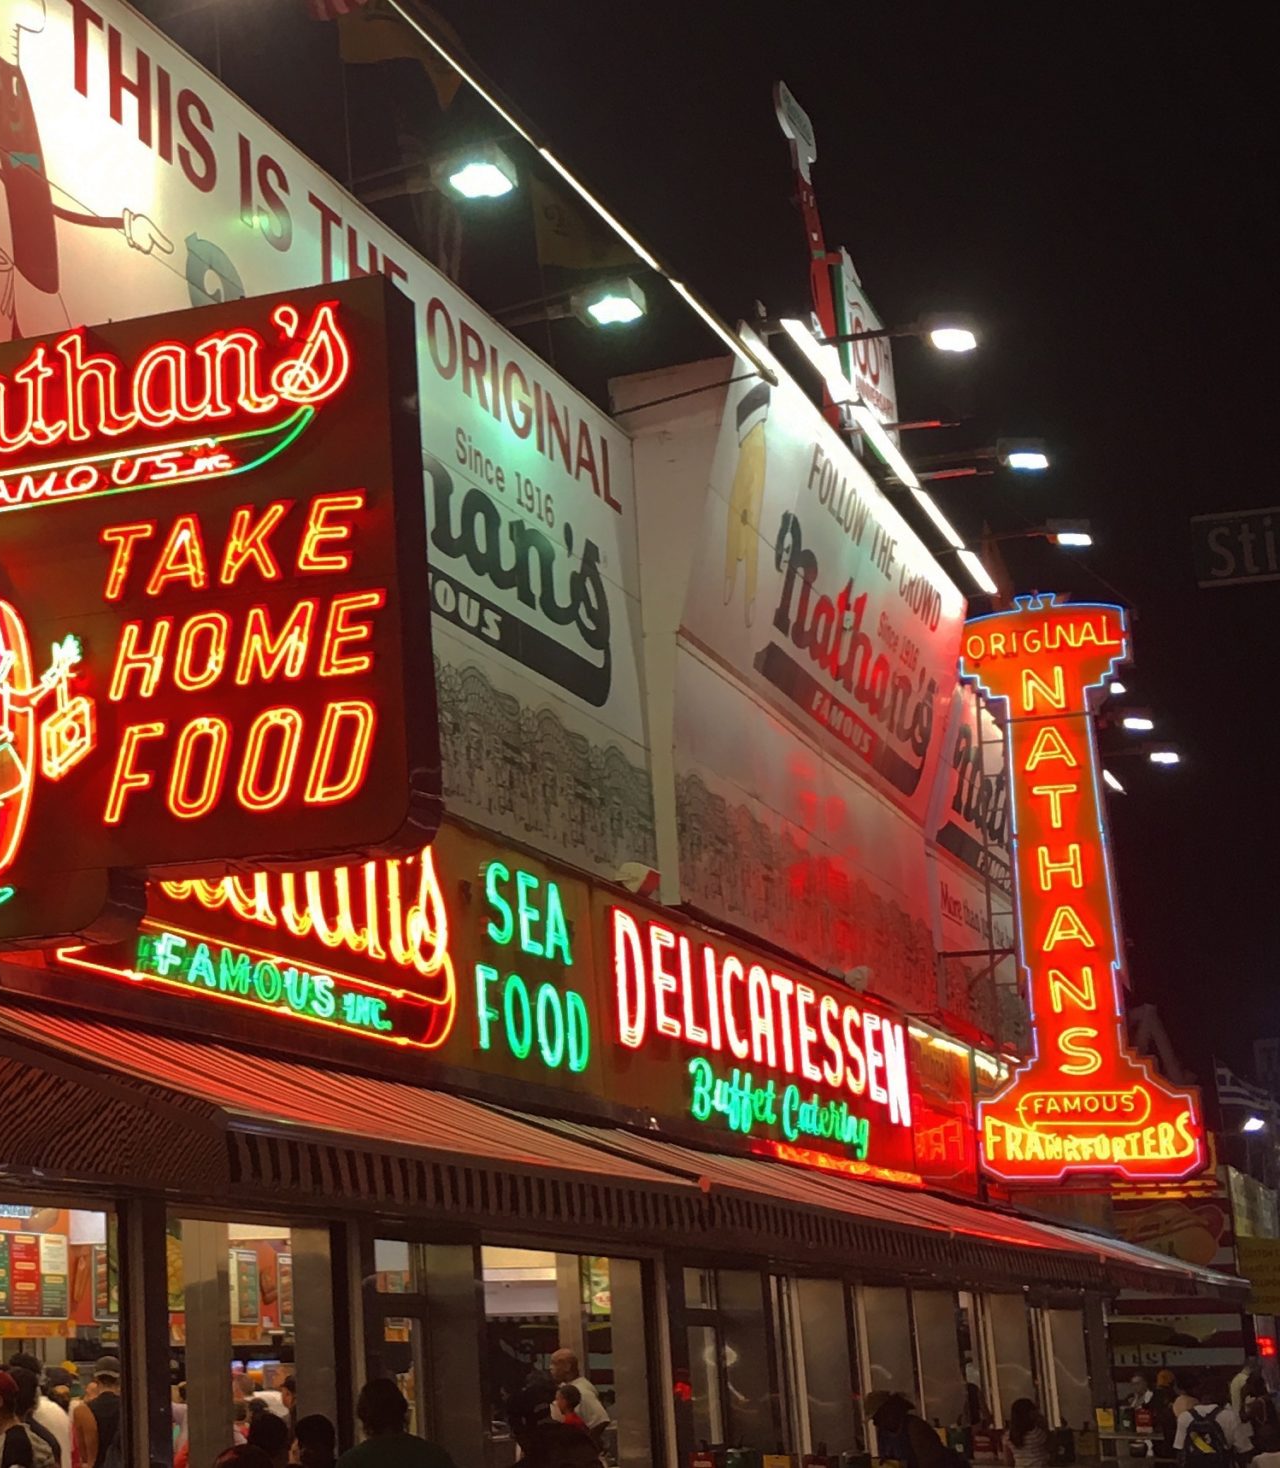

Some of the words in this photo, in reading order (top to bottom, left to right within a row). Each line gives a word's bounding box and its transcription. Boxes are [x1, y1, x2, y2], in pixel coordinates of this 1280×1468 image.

[64, 0, 218, 194] THIS
[238, 131, 293, 253] IS
[426, 296, 623, 516] ORIGINAL
[456, 428, 506, 493] Since
[514, 471, 555, 529] 1916
[102, 492, 364, 600] TAKE
[807, 441, 871, 547] FOLLOW
[869, 522, 899, 582] THE
[898, 563, 942, 633] CROWD
[110, 591, 385, 701] HOME
[427, 571, 503, 642] OUS
[773, 509, 939, 758] Nathan's
[966, 614, 1121, 660] ORIGINAL
[103, 700, 376, 826] FOOD
[810, 689, 873, 754] FAMOUS
[483, 859, 574, 966] SEA
[154, 931, 336, 1019] FAMOUS
[475, 963, 590, 1073] FOOD
[612, 906, 911, 1128] DELICATESSEN
[688, 1056, 778, 1134] Buffet
[781, 1084, 870, 1161] Catering
[983, 1110, 1197, 1163] FRANKFURTERS
[1032, 1095, 1136, 1115] FAMOUS
